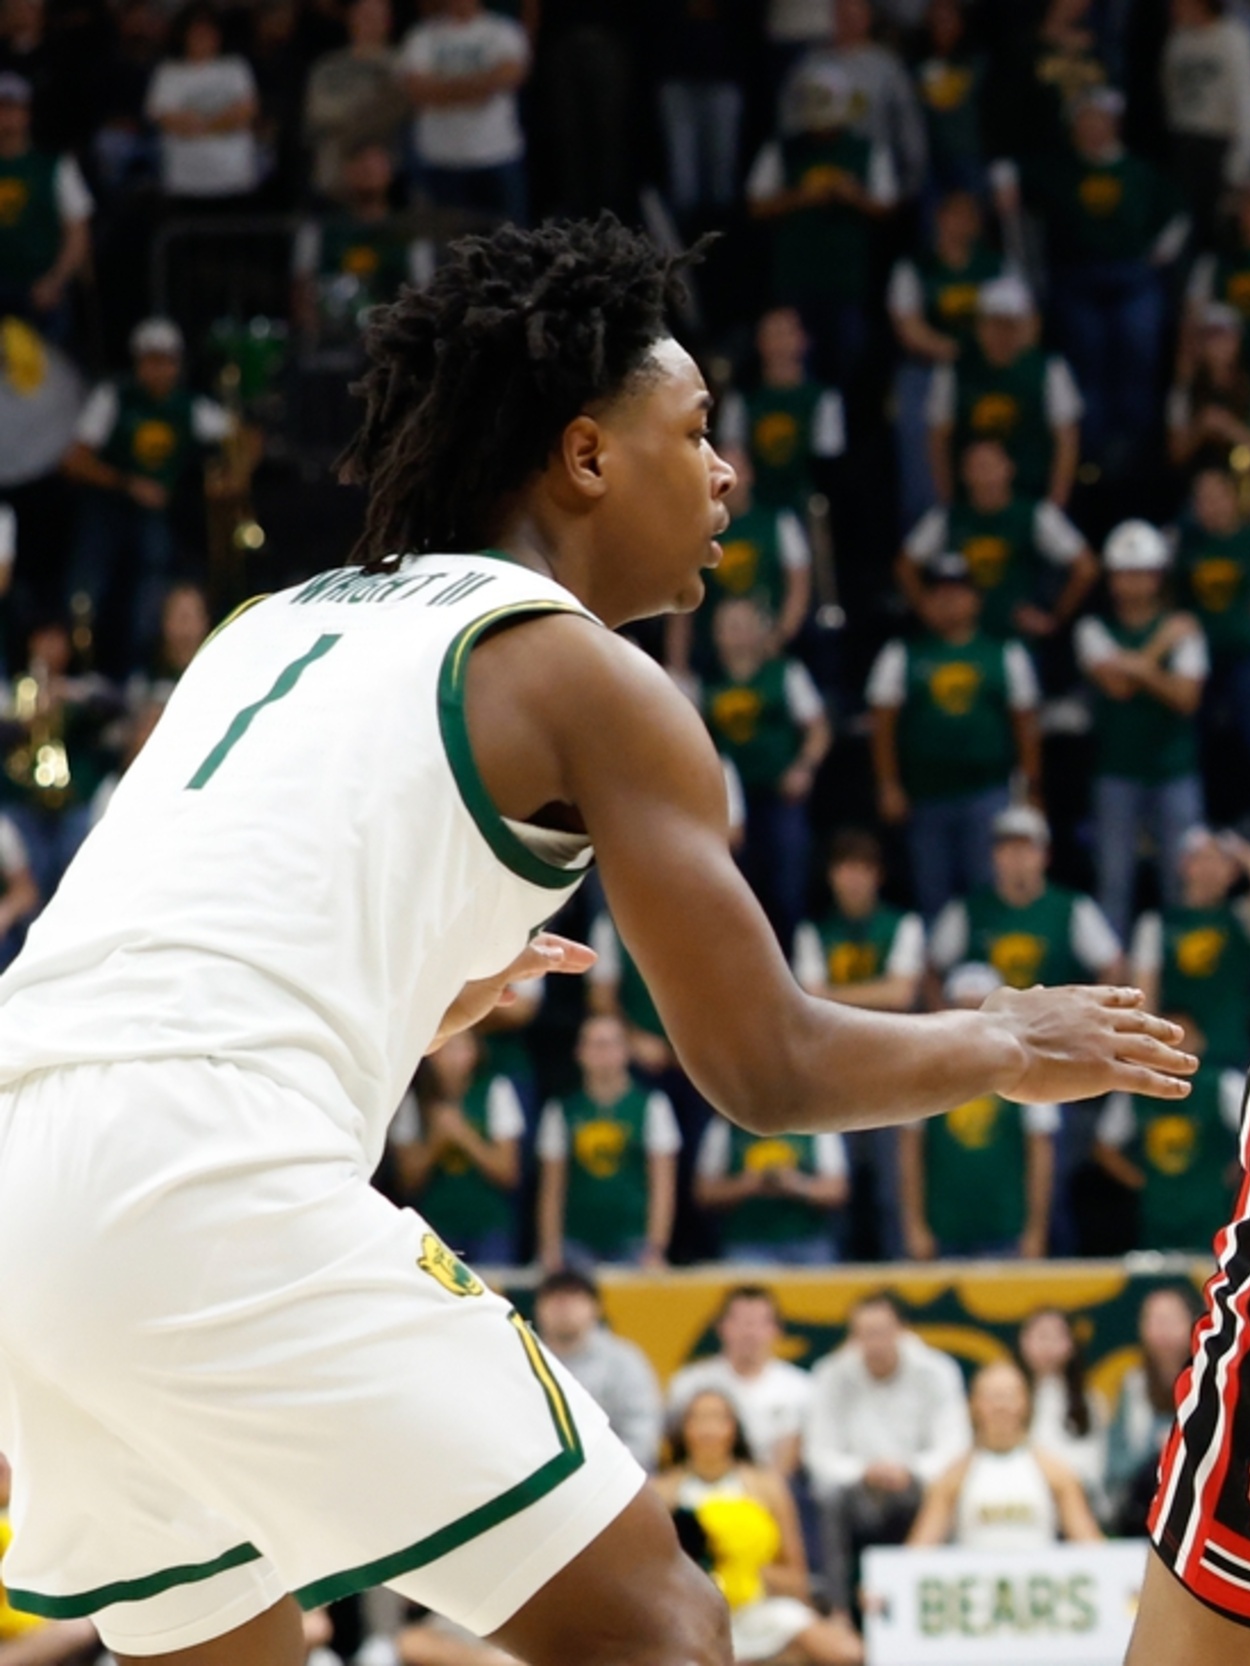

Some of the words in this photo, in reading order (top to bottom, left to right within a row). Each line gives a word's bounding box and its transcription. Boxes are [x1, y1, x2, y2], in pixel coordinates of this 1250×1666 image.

[425, 570, 497, 606] III
[184, 633, 343, 790] 1
[917, 1571, 1099, 1638] BEARS
